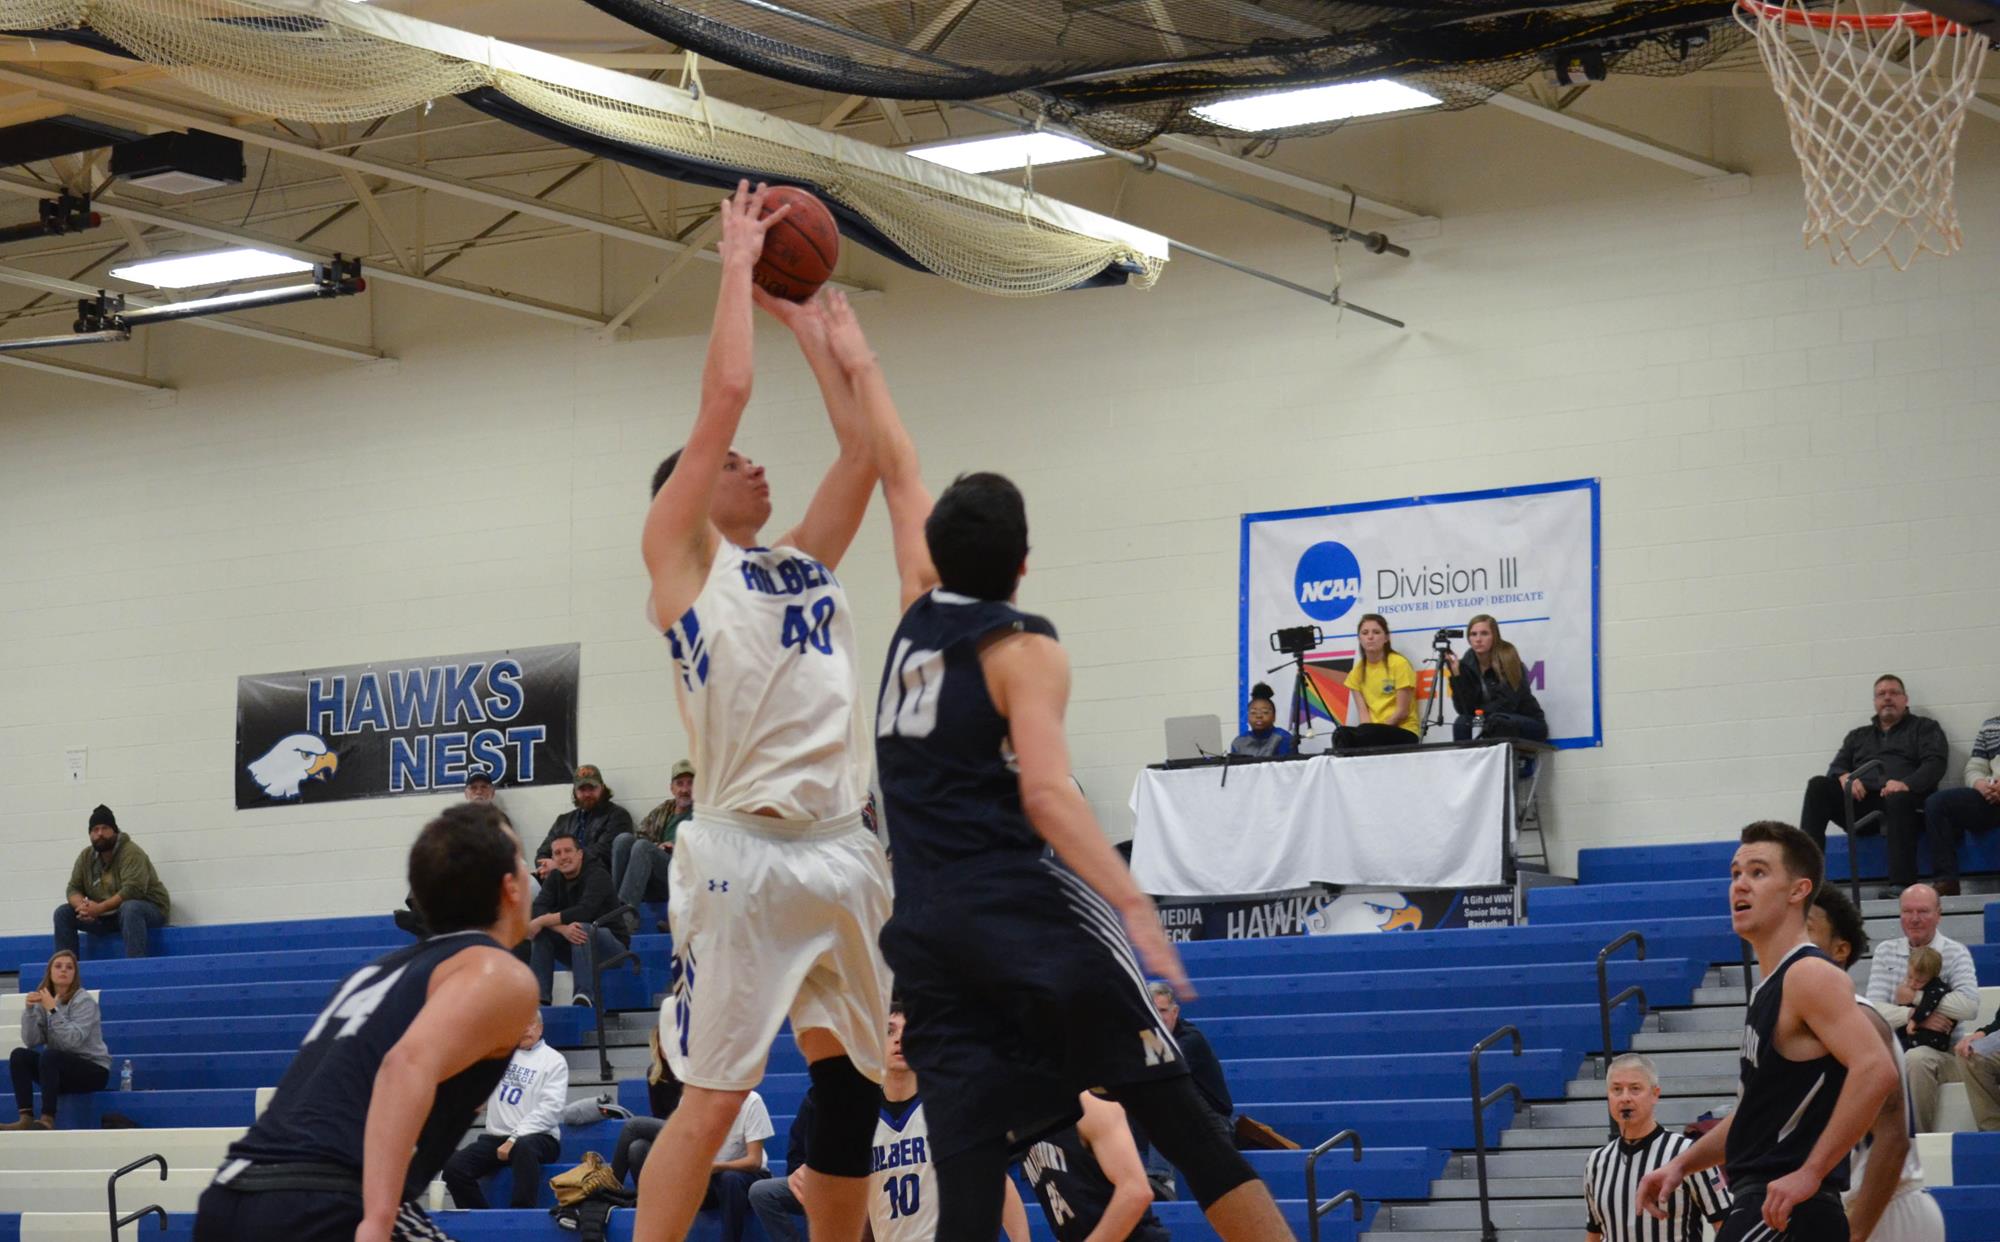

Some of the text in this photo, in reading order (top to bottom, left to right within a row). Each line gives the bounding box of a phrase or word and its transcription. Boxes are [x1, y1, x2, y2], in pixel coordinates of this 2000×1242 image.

[1300, 577, 1361, 604] NCAA
[1377, 556, 1518, 600] Division III
[1377, 590, 1544, 615] DISCOVER DEVELOP DEDICATE
[781, 595, 835, 655] 40
[306, 658, 525, 736] HAWKS
[878, 637, 945, 738] 10
[390, 724, 546, 792] NEST
[1227, 895, 1332, 940] HAWKS
[1464, 906, 1513, 917] Senior Men's
[1470, 895, 1484, 905] Gift
[1485, 894, 1493, 904] of
[1493, 894, 1513, 903] WNY
[1164, 927, 1193, 943] ECK
[301, 964, 410, 1046] 14
[499, 1083, 523, 1106] 10
[872, 1136, 929, 1172] ILBER
[883, 1173, 920, 1220] 10
